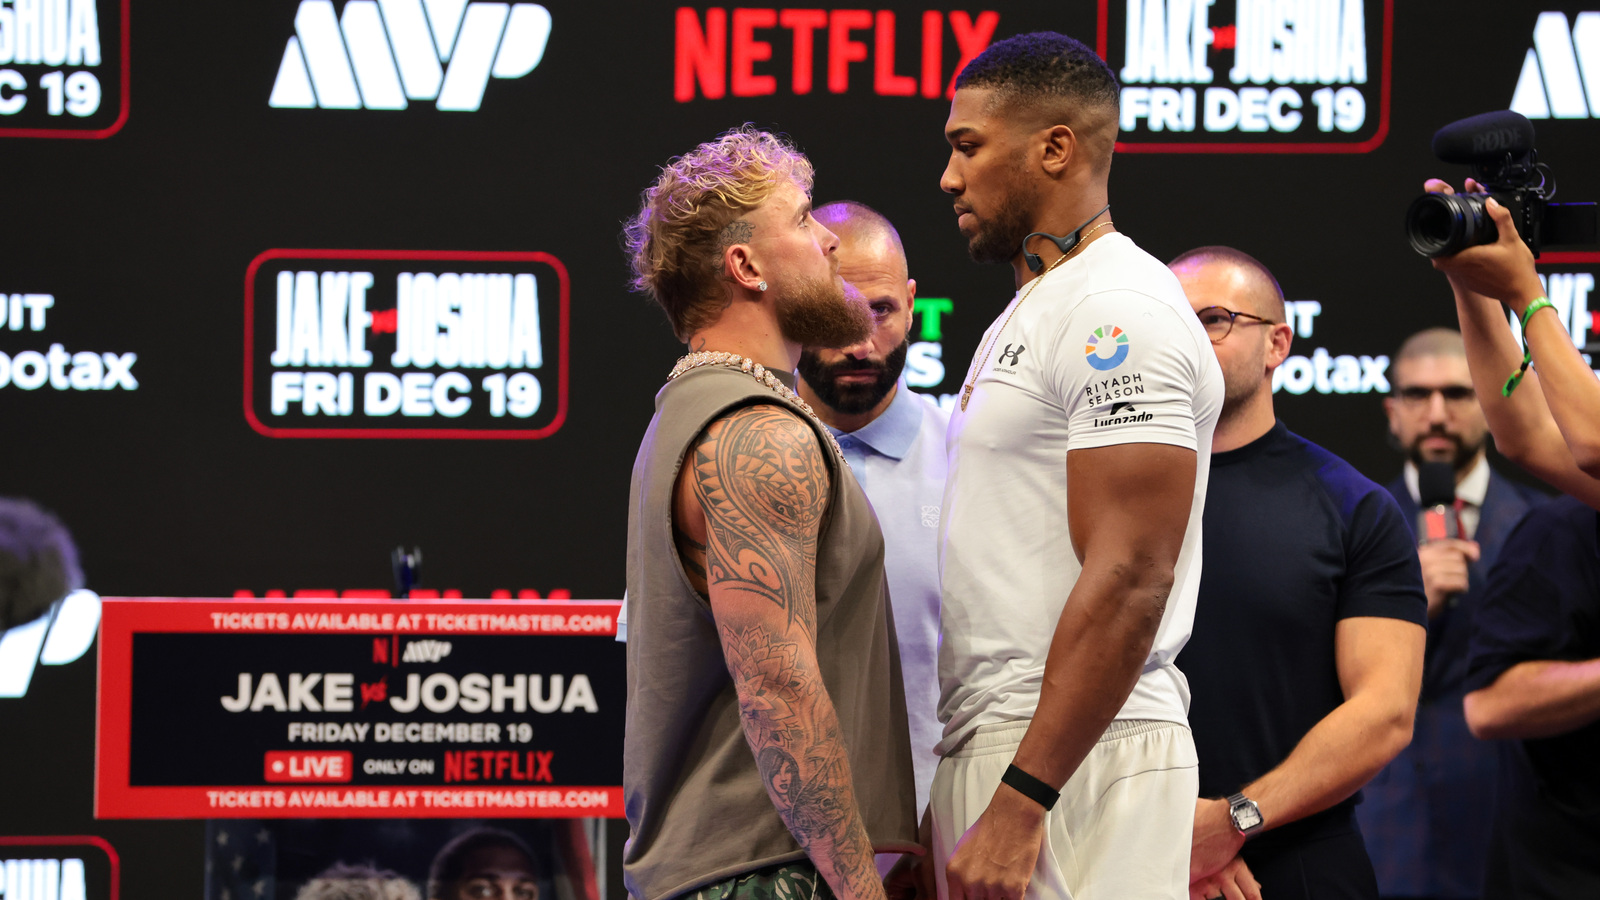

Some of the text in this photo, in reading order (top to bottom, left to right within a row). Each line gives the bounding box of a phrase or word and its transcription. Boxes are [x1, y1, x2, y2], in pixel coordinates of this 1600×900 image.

[674, 7, 1000, 102] NETFLIX
[1120, 0, 1368, 85] JAKE JOSHUA
[40, 70, 101, 117] 19
[1118, 86, 1366, 133] FRI DEC 19
[270, 270, 543, 369] JAKE JOSHUA
[1086, 373, 1142, 396] RIYADH
[1272, 347, 1391, 395] otax
[271, 371, 542, 418] FRI DEC 19
[1088, 385, 1145, 408] SEASON
[211, 612, 612, 632] TICKETS AVAILABLE AT TICKETMASTER.COM
[221, 673, 354, 712] JAKE
[390, 673, 599, 713] JOSHUA
[288, 722, 533, 743] FRIDAY DECEMBER 19
[289, 750, 554, 783] LIVE ONLY ON NETFLIX
[207, 790, 609, 808] TICKETS AVAILABLE AT TICKETMASTER.COM
